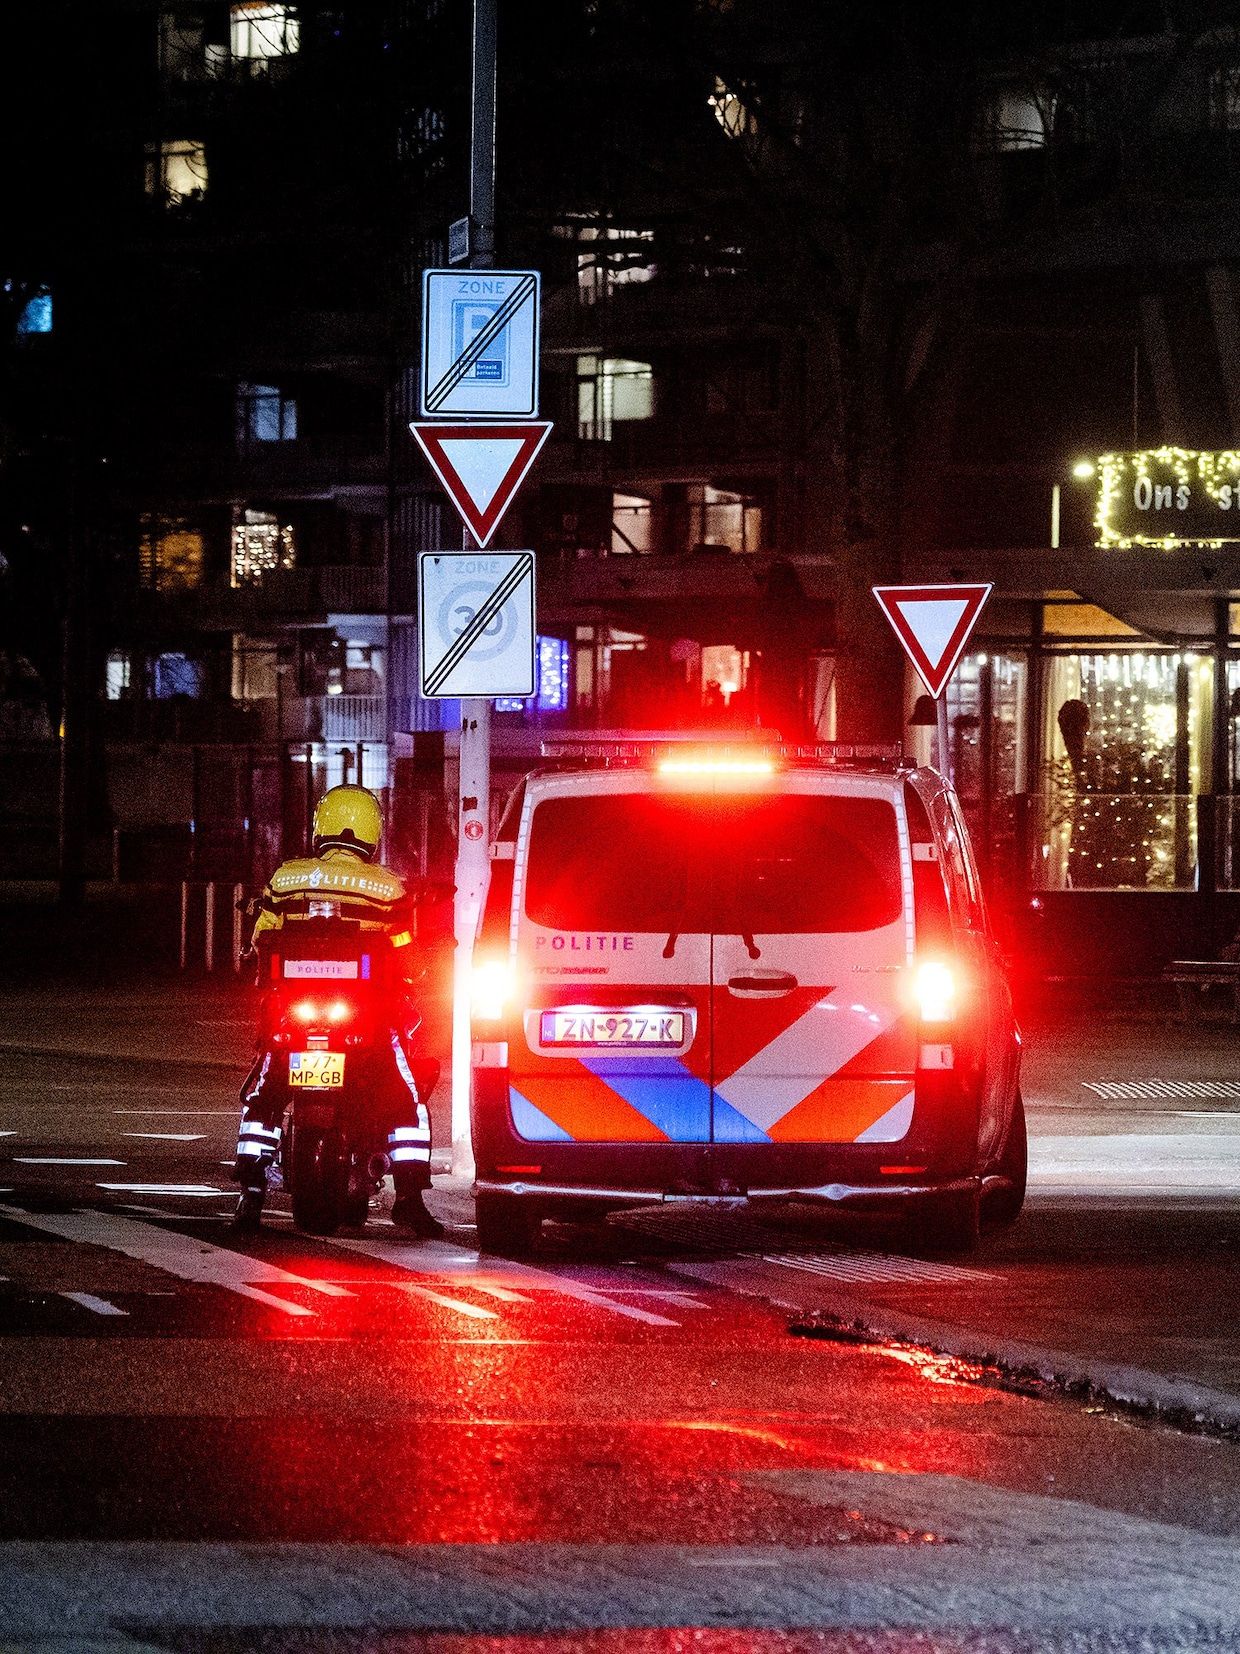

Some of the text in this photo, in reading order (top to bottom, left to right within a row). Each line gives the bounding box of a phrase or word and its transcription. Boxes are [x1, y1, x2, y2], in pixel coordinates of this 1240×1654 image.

[458, 281, 505, 294] ZONE
[1134, 476, 1191, 510] Ons
[455, 561, 500, 574] ZONE
[454, 605, 503, 636] 30
[535, 936, 634, 951] POLITIE
[297, 966, 342, 974] POLITIE
[562, 1018, 675, 1042] ZN-927-K
[291, 1070, 341, 1084] MP-GB
